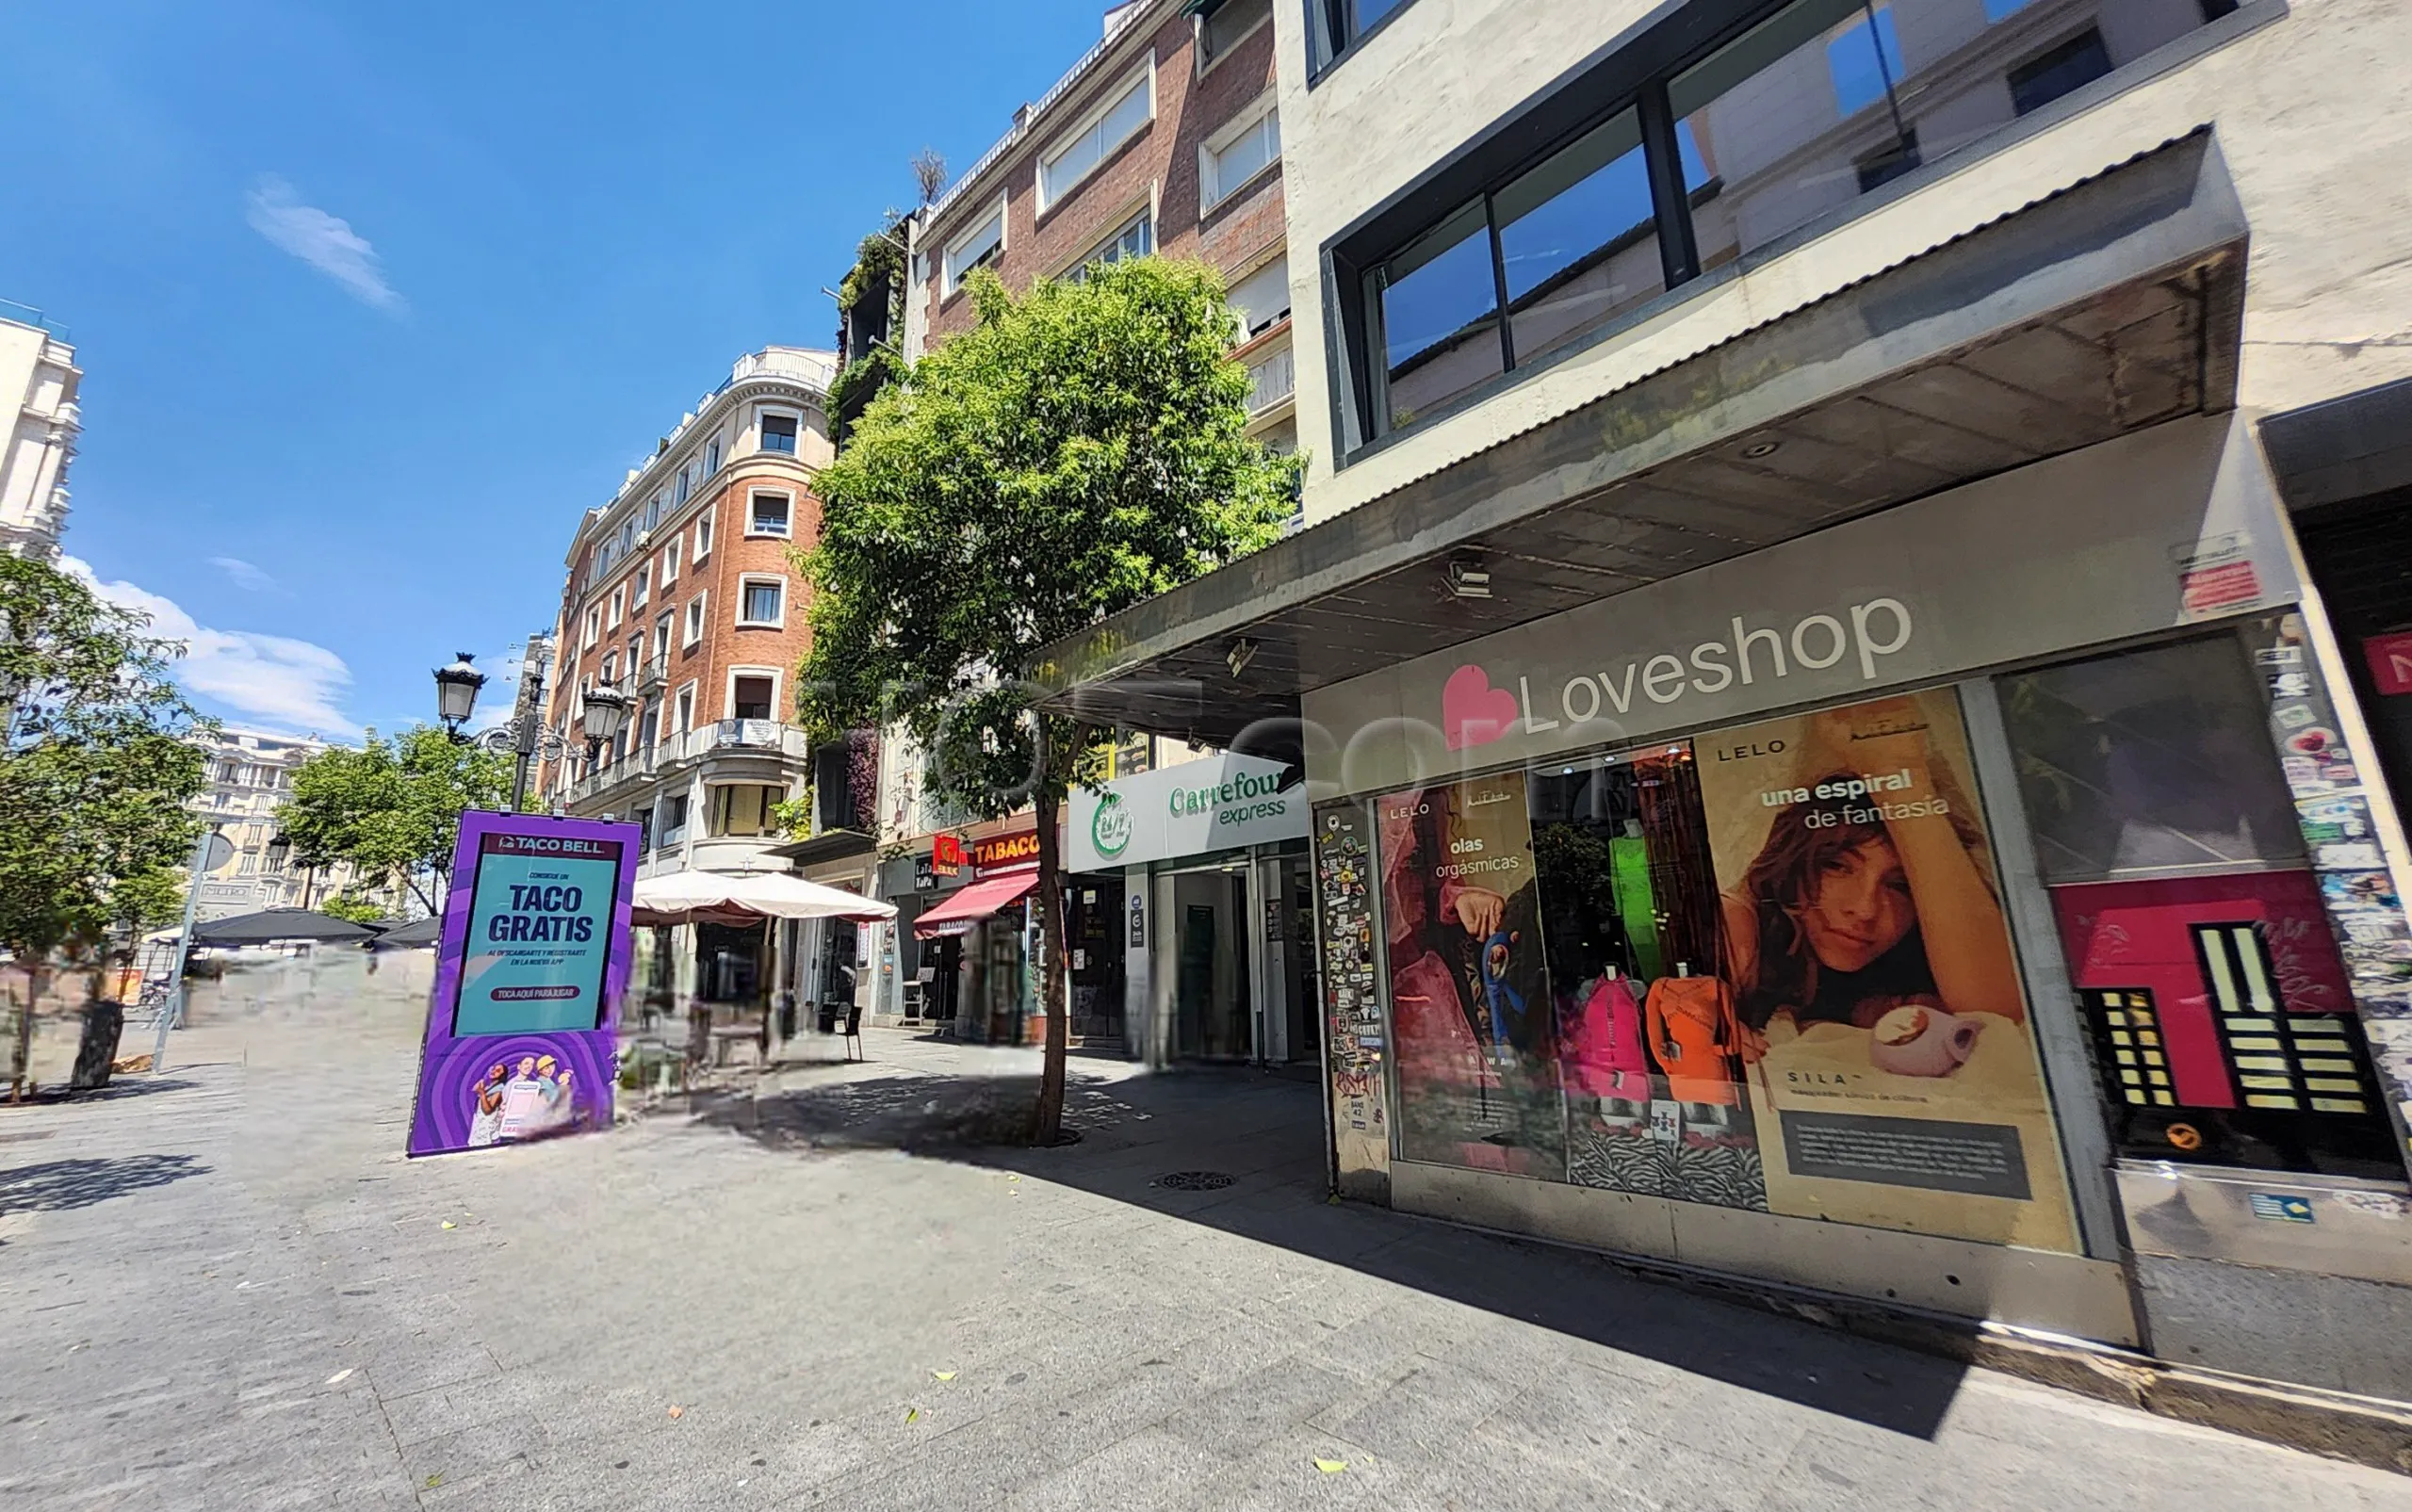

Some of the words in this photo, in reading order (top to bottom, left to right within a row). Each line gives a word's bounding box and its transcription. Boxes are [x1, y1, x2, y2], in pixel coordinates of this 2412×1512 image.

[1520, 596, 1912, 735] Loveshop
[1718, 740, 1785, 761] LELO
[1761, 784, 1810, 807] una
[1815, 768, 1912, 805] espiral
[1219, 800, 1286, 827] express
[1390, 803, 1429, 820] LELO
[1803, 804, 1838, 830] de
[1842, 794, 1950, 825] fantasía
[515, 837, 561, 851] TACO
[562, 840, 604, 854] BELL
[975, 834, 1040, 864] TABACO
[1450, 837, 1484, 854] olas
[1435, 855, 1520, 879] orgásmicas
[509, 885, 583, 913] TACO
[488, 915, 594, 944] GRATIS
[497, 990, 516, 999] TOCA
[534, 988, 554, 998] PARA
[1786, 1071, 1847, 1084] SILA
